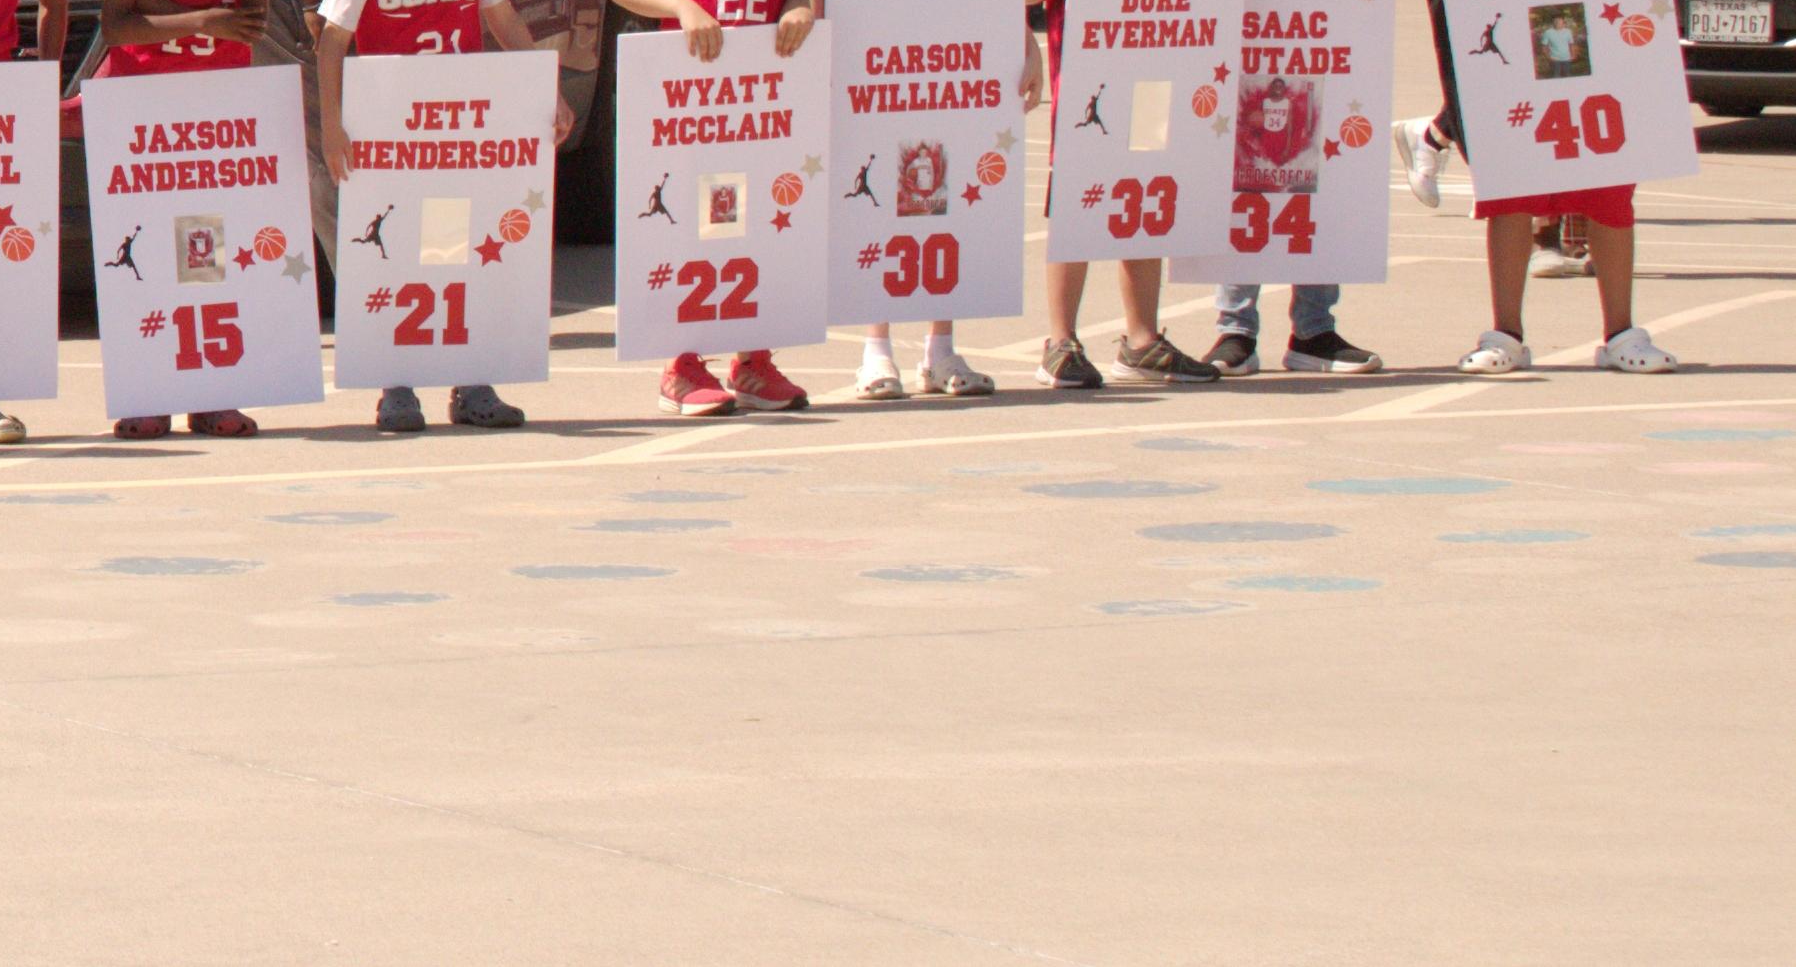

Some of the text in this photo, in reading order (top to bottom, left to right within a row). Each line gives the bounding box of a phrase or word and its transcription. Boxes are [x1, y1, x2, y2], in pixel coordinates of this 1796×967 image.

[1083, 19, 1216, 49] EVERMAN
[1242, 11, 1327, 39] SAAC
[866, 43, 981, 75] CARSON
[1241, 47, 1351, 74] UTADE
[663, 73, 783, 107] WYATT
[848, 80, 1000, 113] WILLIAMS
[405, 100, 489, 130] JETT
[653, 110, 792, 147] MCCLAIN
[1506, 94, 1624, 159] #40
[130, 118, 256, 153] JAXSON
[352, 137, 538, 169] HENDERSON
[107, 155, 277, 194] ANDERSON
